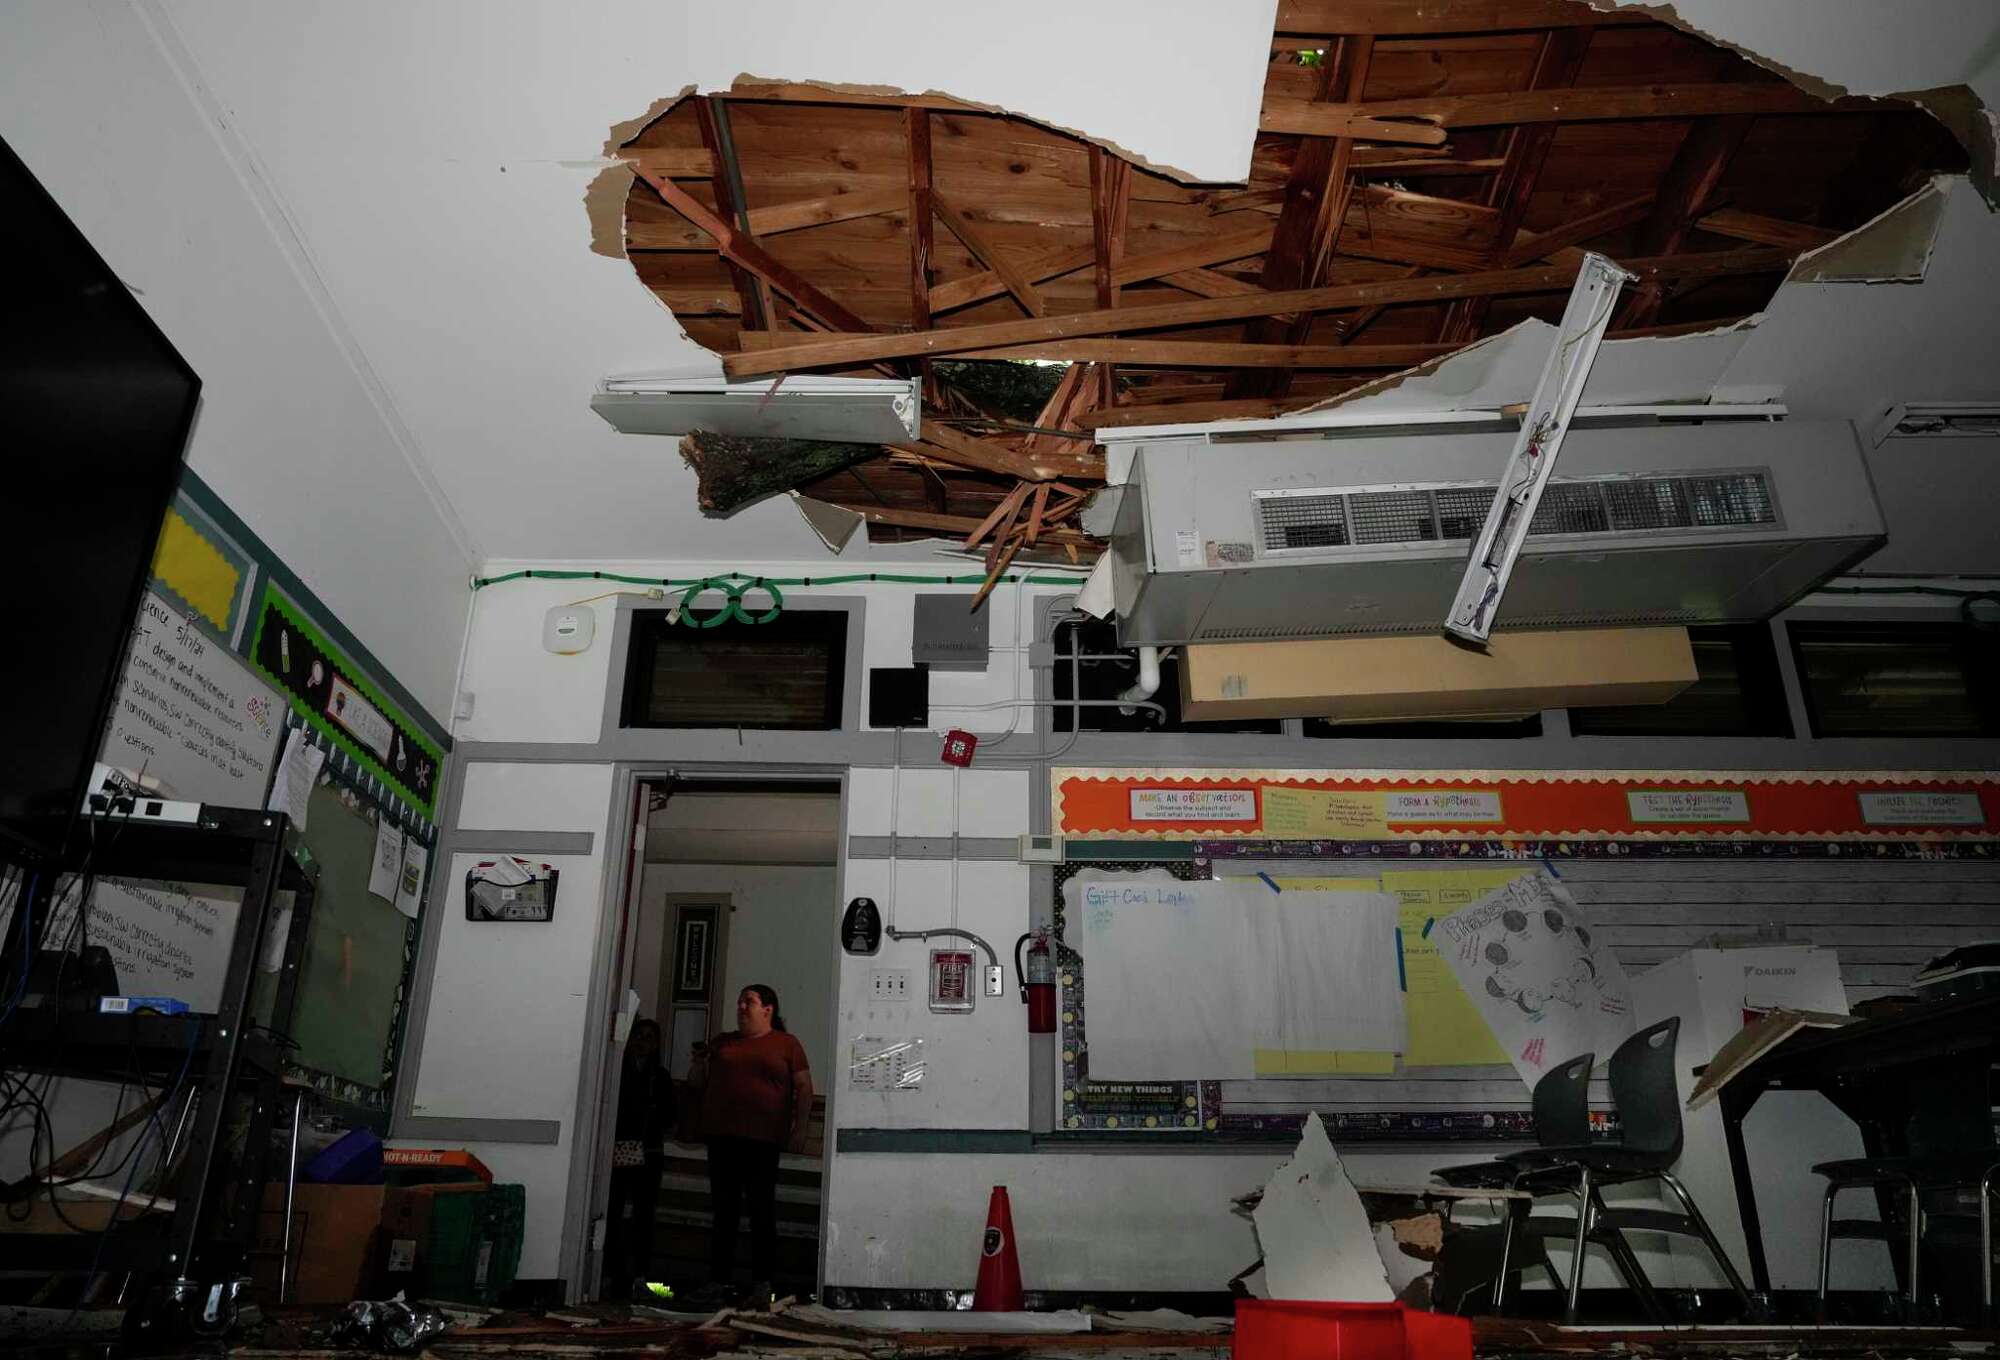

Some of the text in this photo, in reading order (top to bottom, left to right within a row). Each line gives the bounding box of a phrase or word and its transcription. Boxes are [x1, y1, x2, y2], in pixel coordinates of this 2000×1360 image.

[1755, 967, 1797, 976] DAIKIN
[1087, 1085, 1173, 1094] TRY NEW THINGS
